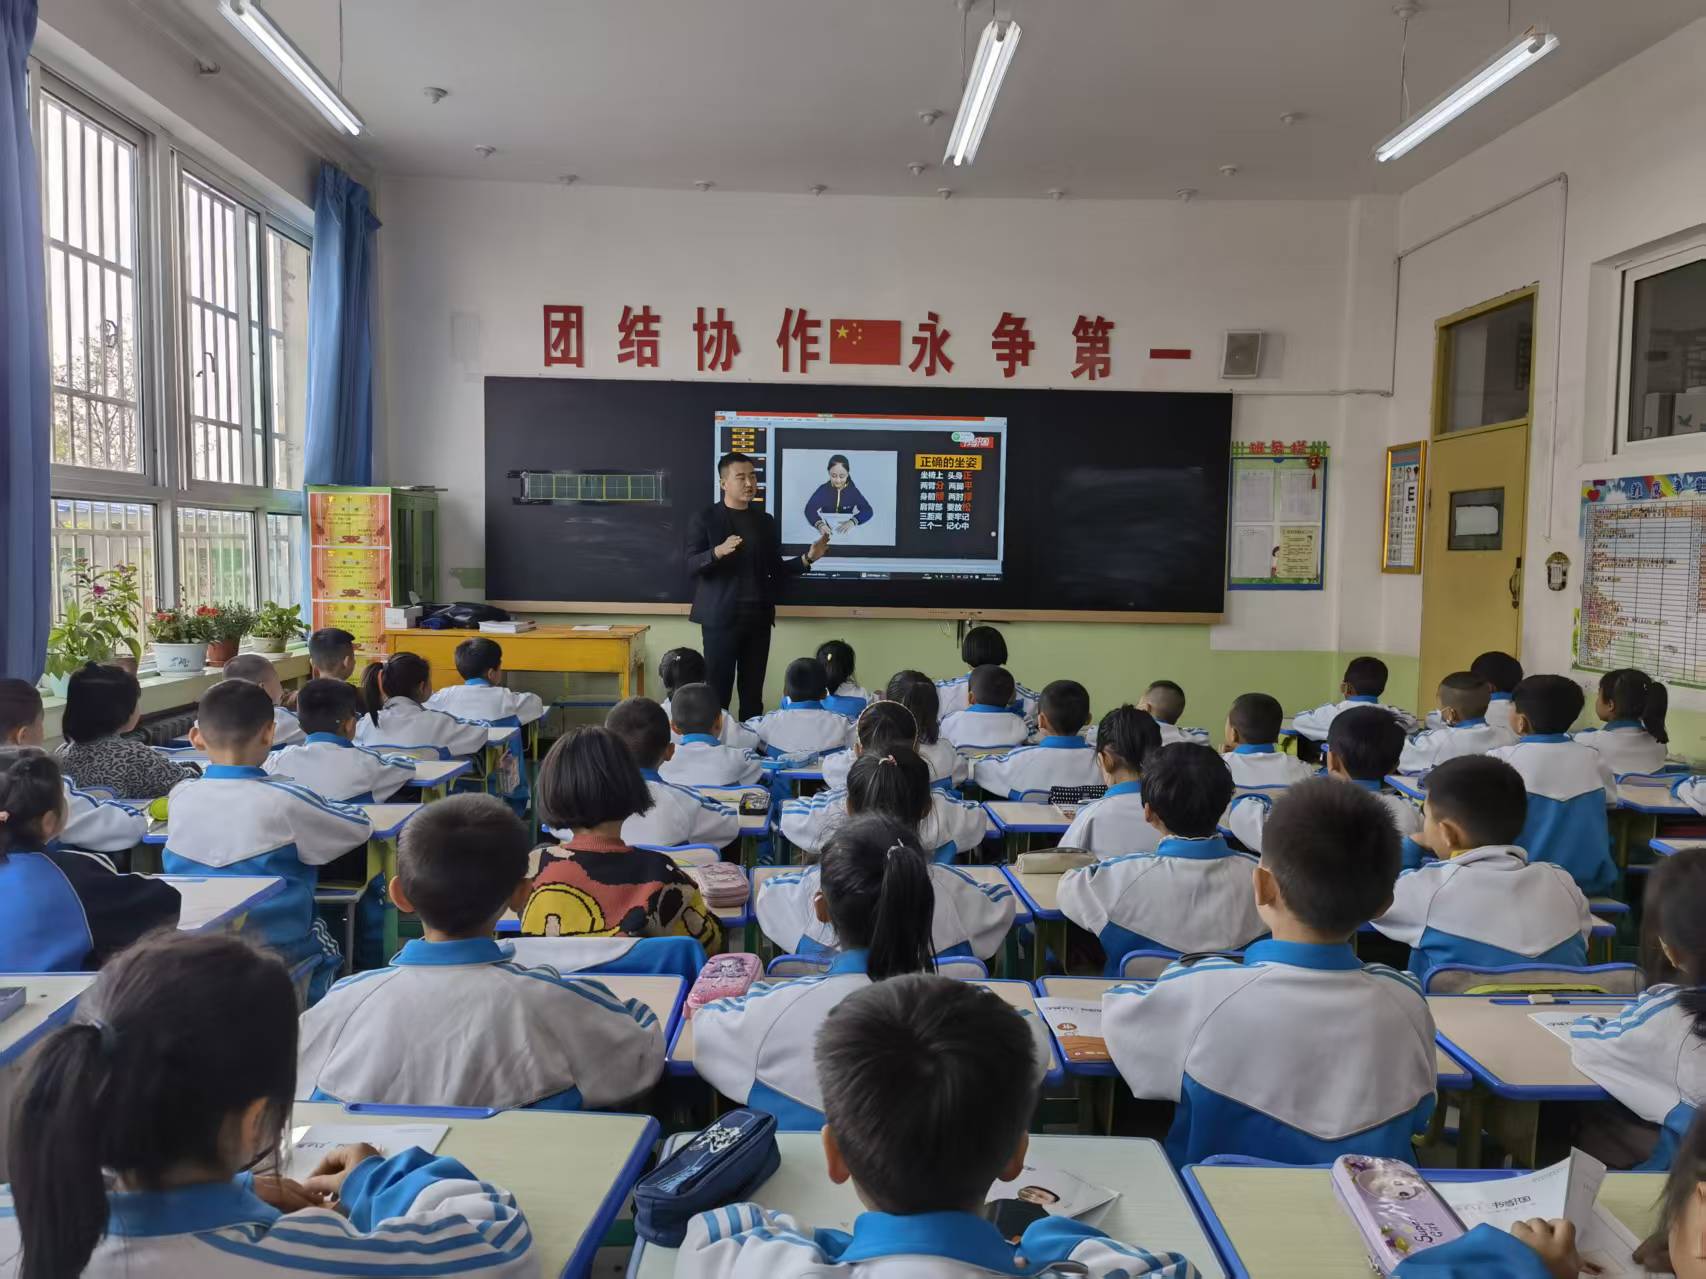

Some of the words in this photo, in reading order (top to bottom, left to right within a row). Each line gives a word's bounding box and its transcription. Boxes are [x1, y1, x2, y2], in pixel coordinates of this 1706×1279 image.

[543, 304, 822, 374] 团结协作
[908, 311, 1192, 381] 永争第一
[920, 456, 977, 468] 正确的坐姿
[947, 471, 973, 480] 头身正
[919, 521, 943, 530] 三个一
[946, 522, 970, 530] 记心中
